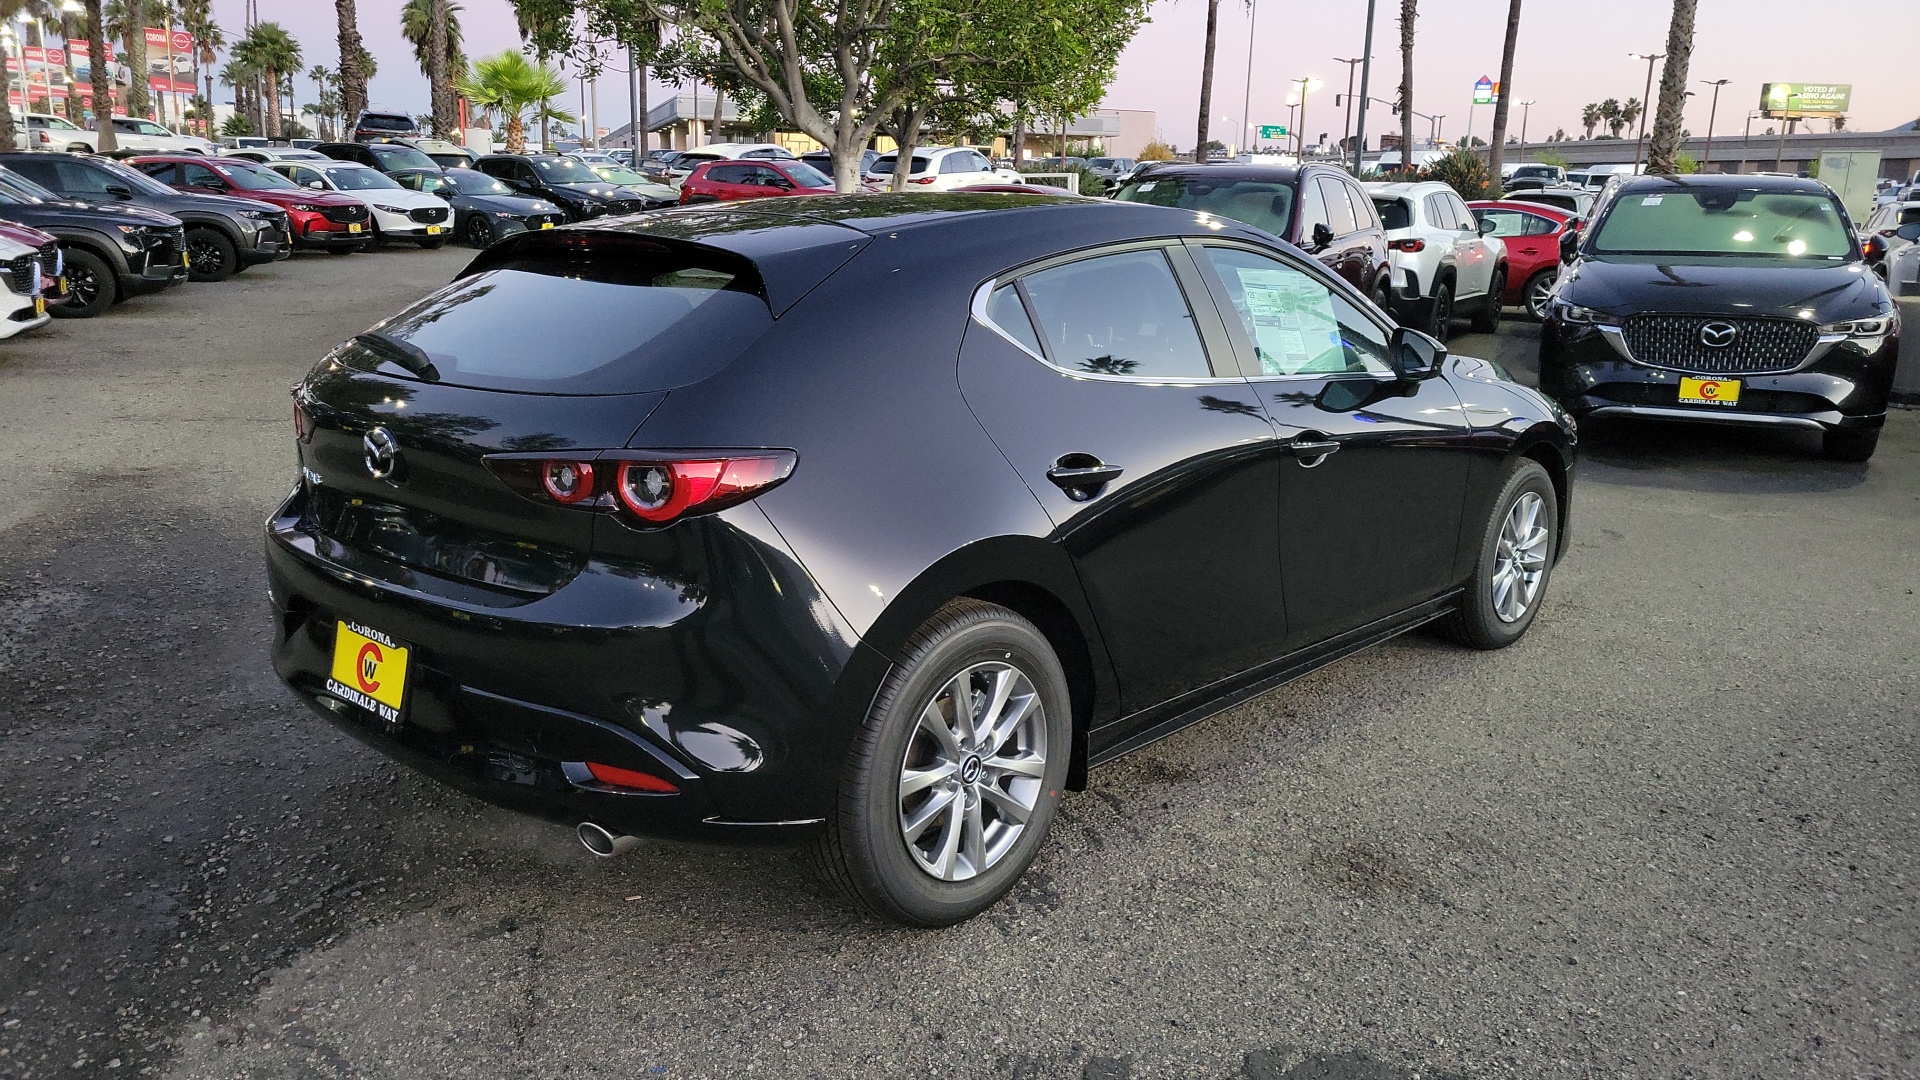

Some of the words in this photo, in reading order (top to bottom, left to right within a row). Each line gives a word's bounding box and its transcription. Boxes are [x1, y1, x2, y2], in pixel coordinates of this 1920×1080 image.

[145, 32, 167, 43] CORONA
[1820, 92, 1846, 100] AGAIN!
[351, 621, 392, 647] CORONA
[326, 679, 377, 712] CARDINALE
[379, 703, 399, 723] WAY
